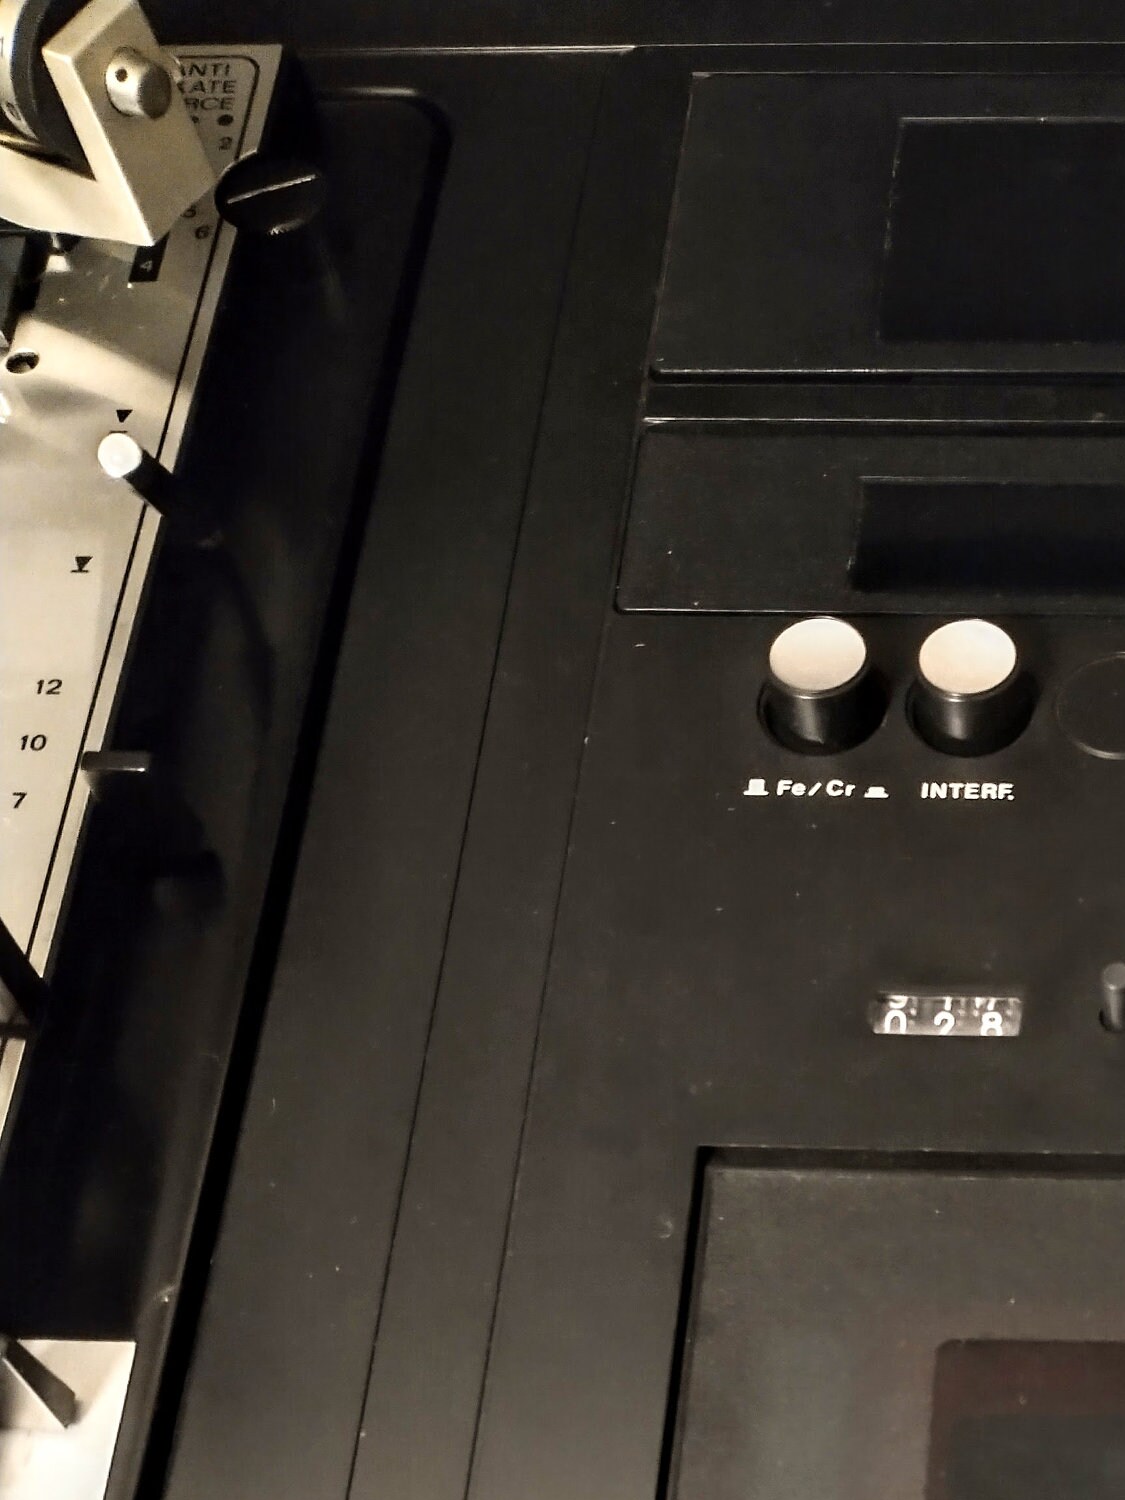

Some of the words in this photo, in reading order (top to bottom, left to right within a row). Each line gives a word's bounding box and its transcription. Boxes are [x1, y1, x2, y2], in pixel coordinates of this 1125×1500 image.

[36, 678, 63, 696] 12
[20, 734, 48, 752] 10
[12, 791, 28, 809] 7
[920, 781, 1015, 801] INTERF.
